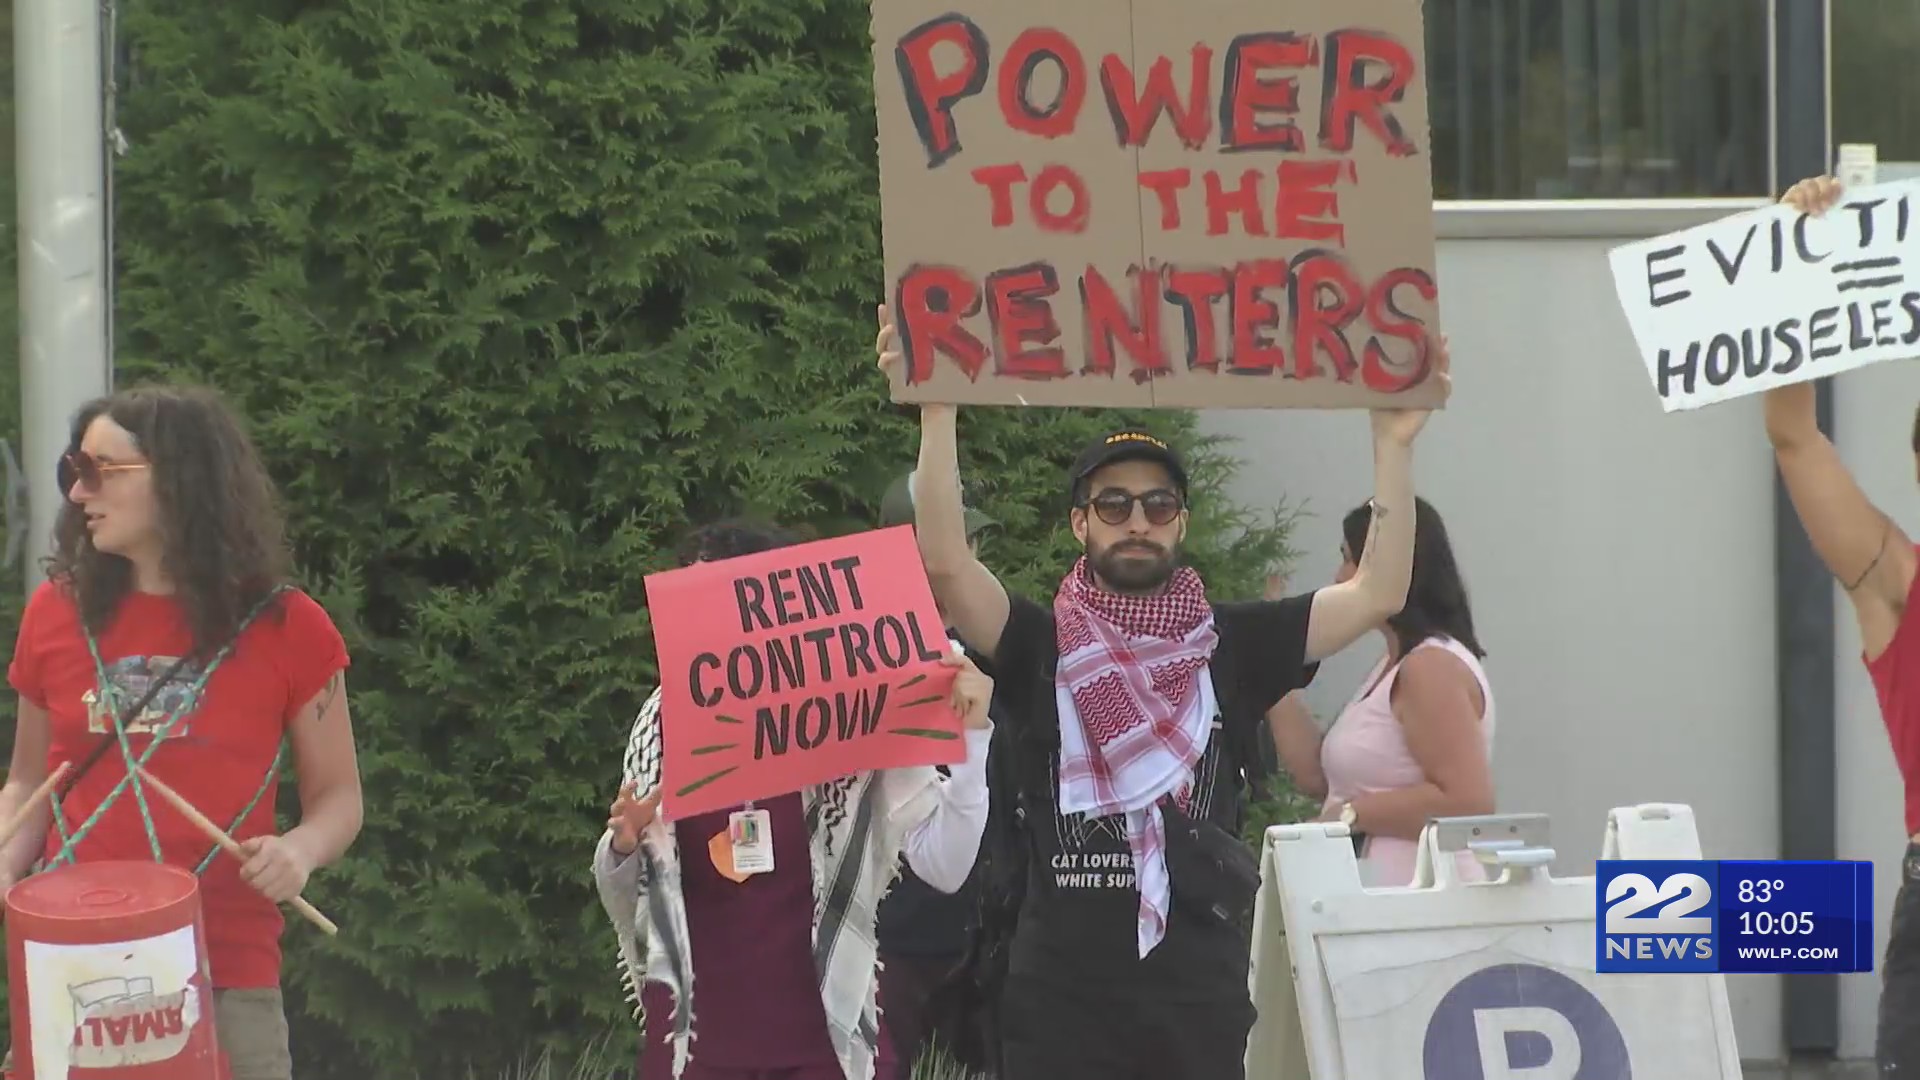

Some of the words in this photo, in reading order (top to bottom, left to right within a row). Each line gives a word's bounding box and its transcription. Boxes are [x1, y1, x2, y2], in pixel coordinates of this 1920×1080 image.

[895, 12, 1418, 168] POWER
[971, 162, 1091, 234] TO
[1137, 159, 1357, 247] THE
[896, 248, 1437, 393] RENTERS
[1657, 291, 1920, 397] HOUSELES
[733, 555, 864, 633] RENT
[689, 611, 943, 708] CONTROL
[754, 683, 889, 760] NOW
[1051, 854, 1079, 868] CAT
[1055, 873, 1102, 888] WHITE
